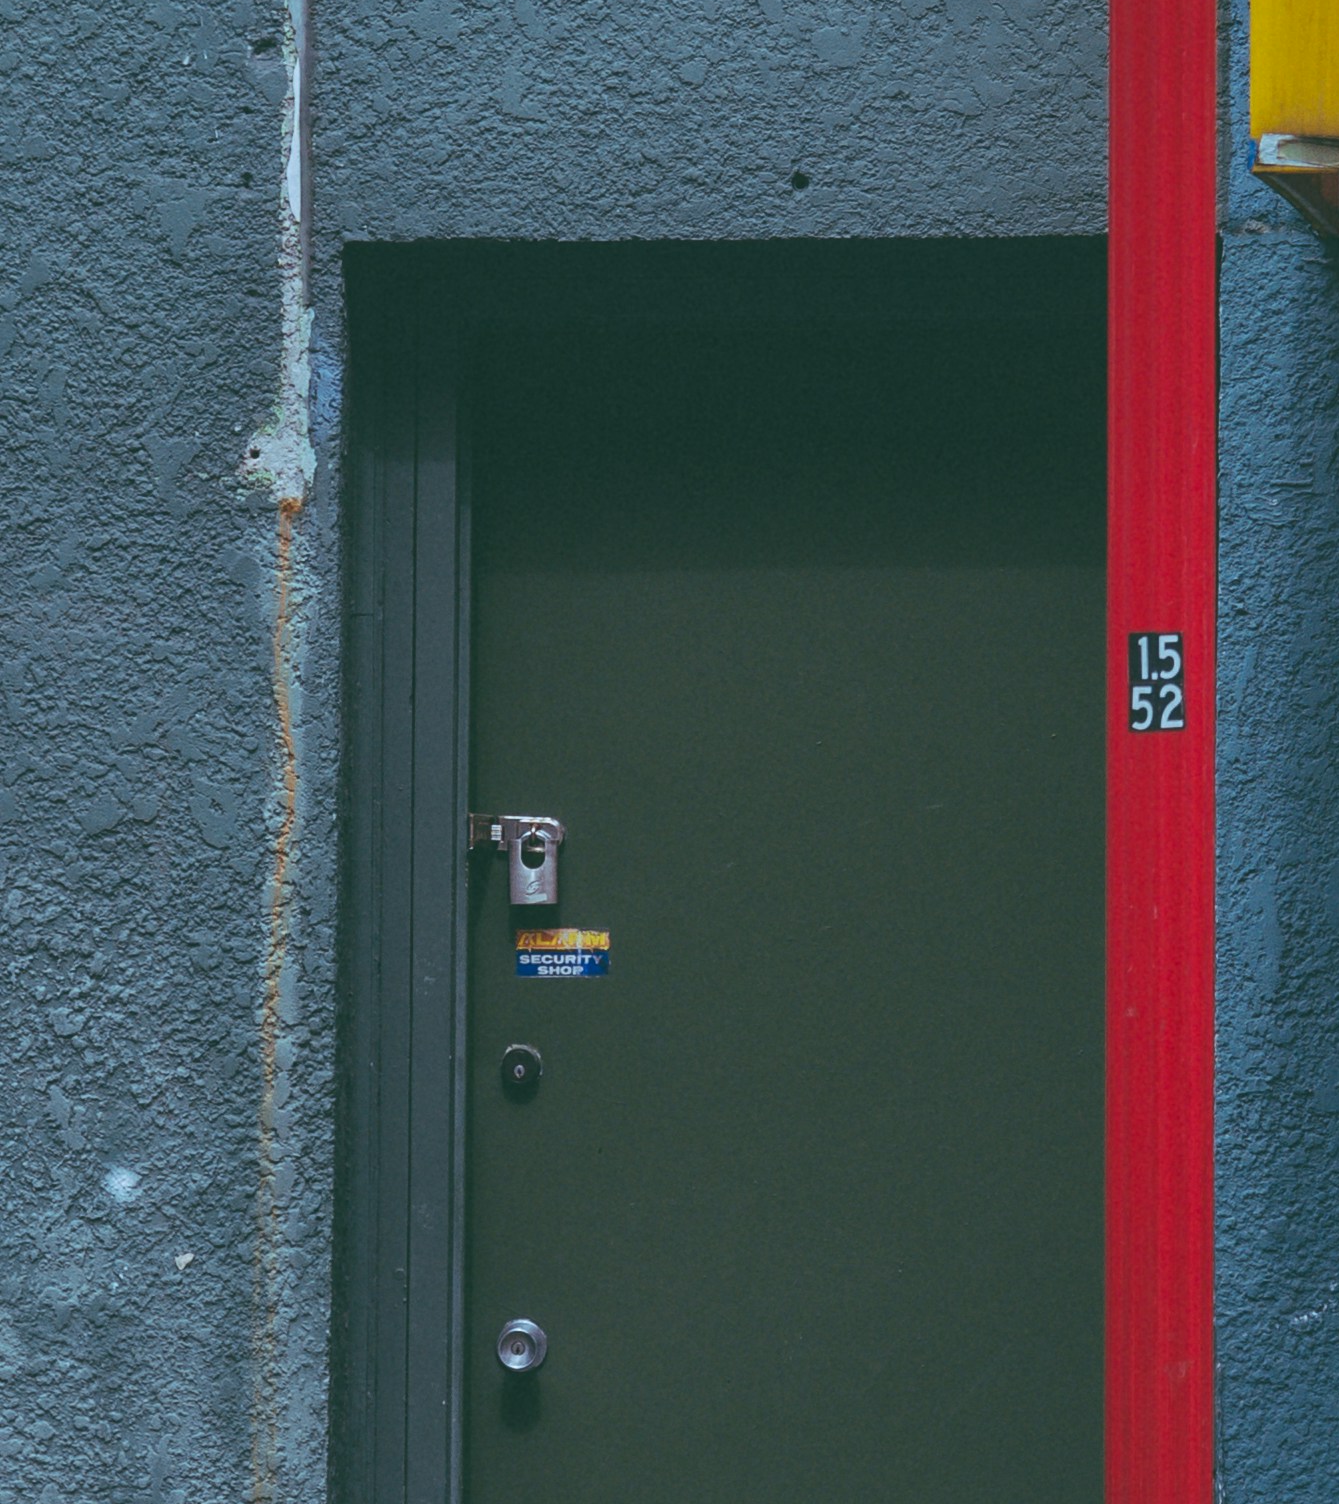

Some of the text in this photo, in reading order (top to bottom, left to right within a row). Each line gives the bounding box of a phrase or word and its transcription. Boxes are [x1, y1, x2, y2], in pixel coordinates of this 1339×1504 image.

[1131, 684, 1184, 731] 52
[519, 954, 602, 965] SECURITY
[537, 965, 584, 976] SHOP
